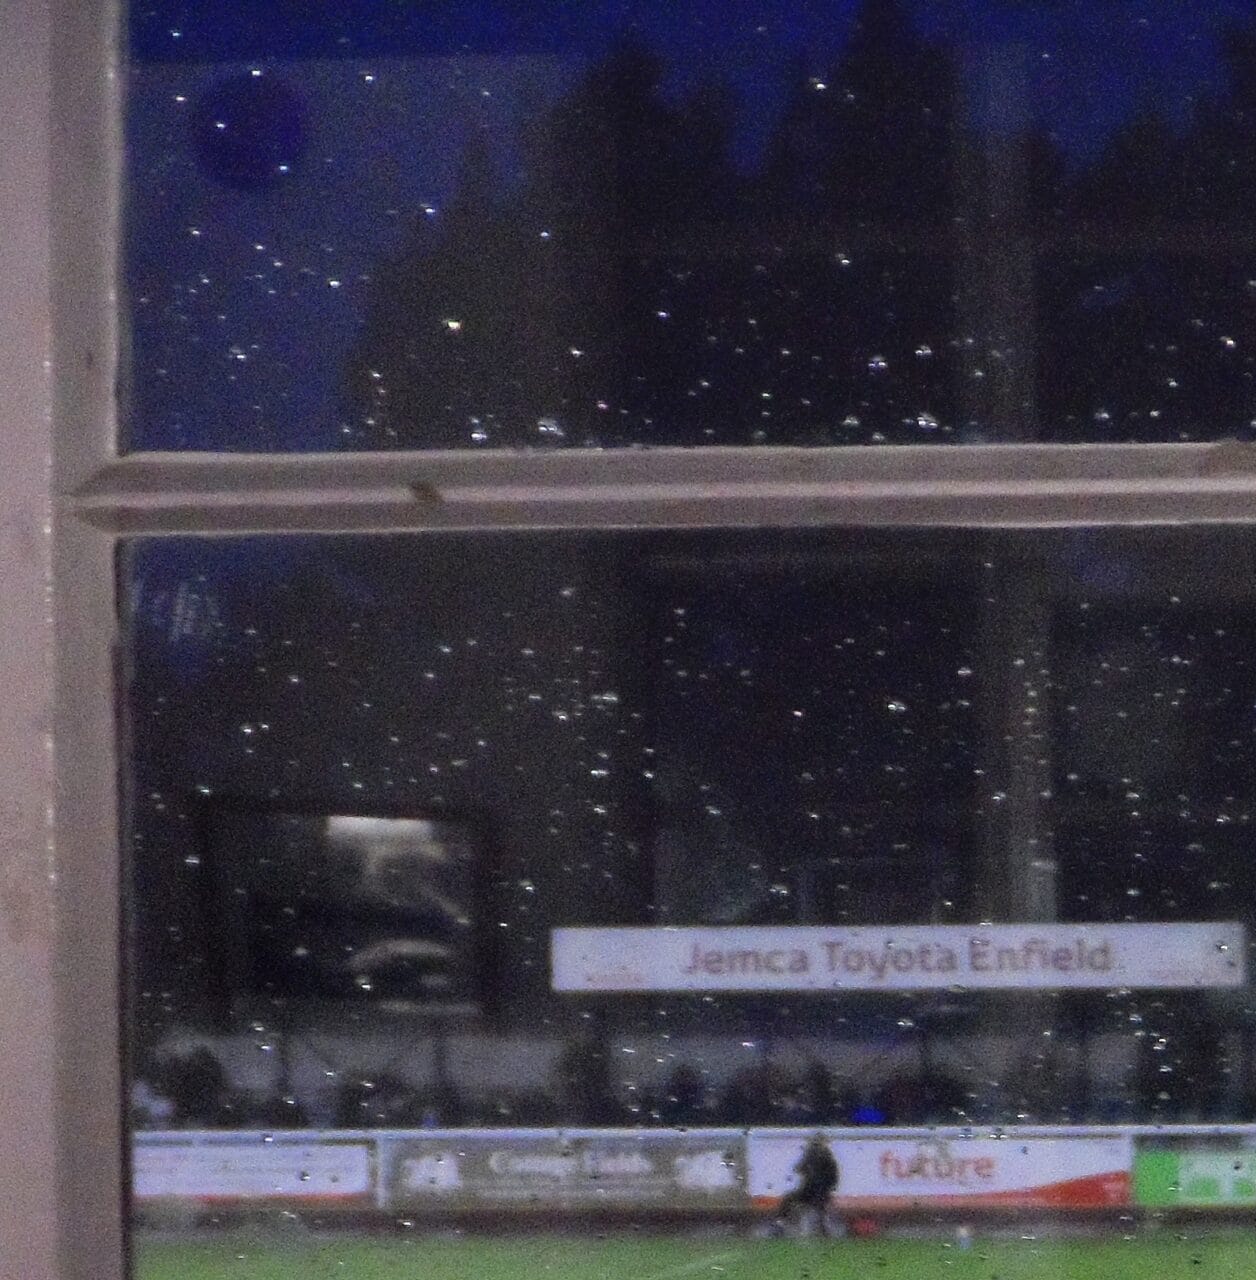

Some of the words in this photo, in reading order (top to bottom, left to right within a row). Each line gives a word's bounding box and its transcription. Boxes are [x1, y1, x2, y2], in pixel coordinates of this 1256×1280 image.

[685, 943, 809, 976] Jemca
[820, 940, 960, 981] Toyota
[969, 938, 1113, 974] Enfield
